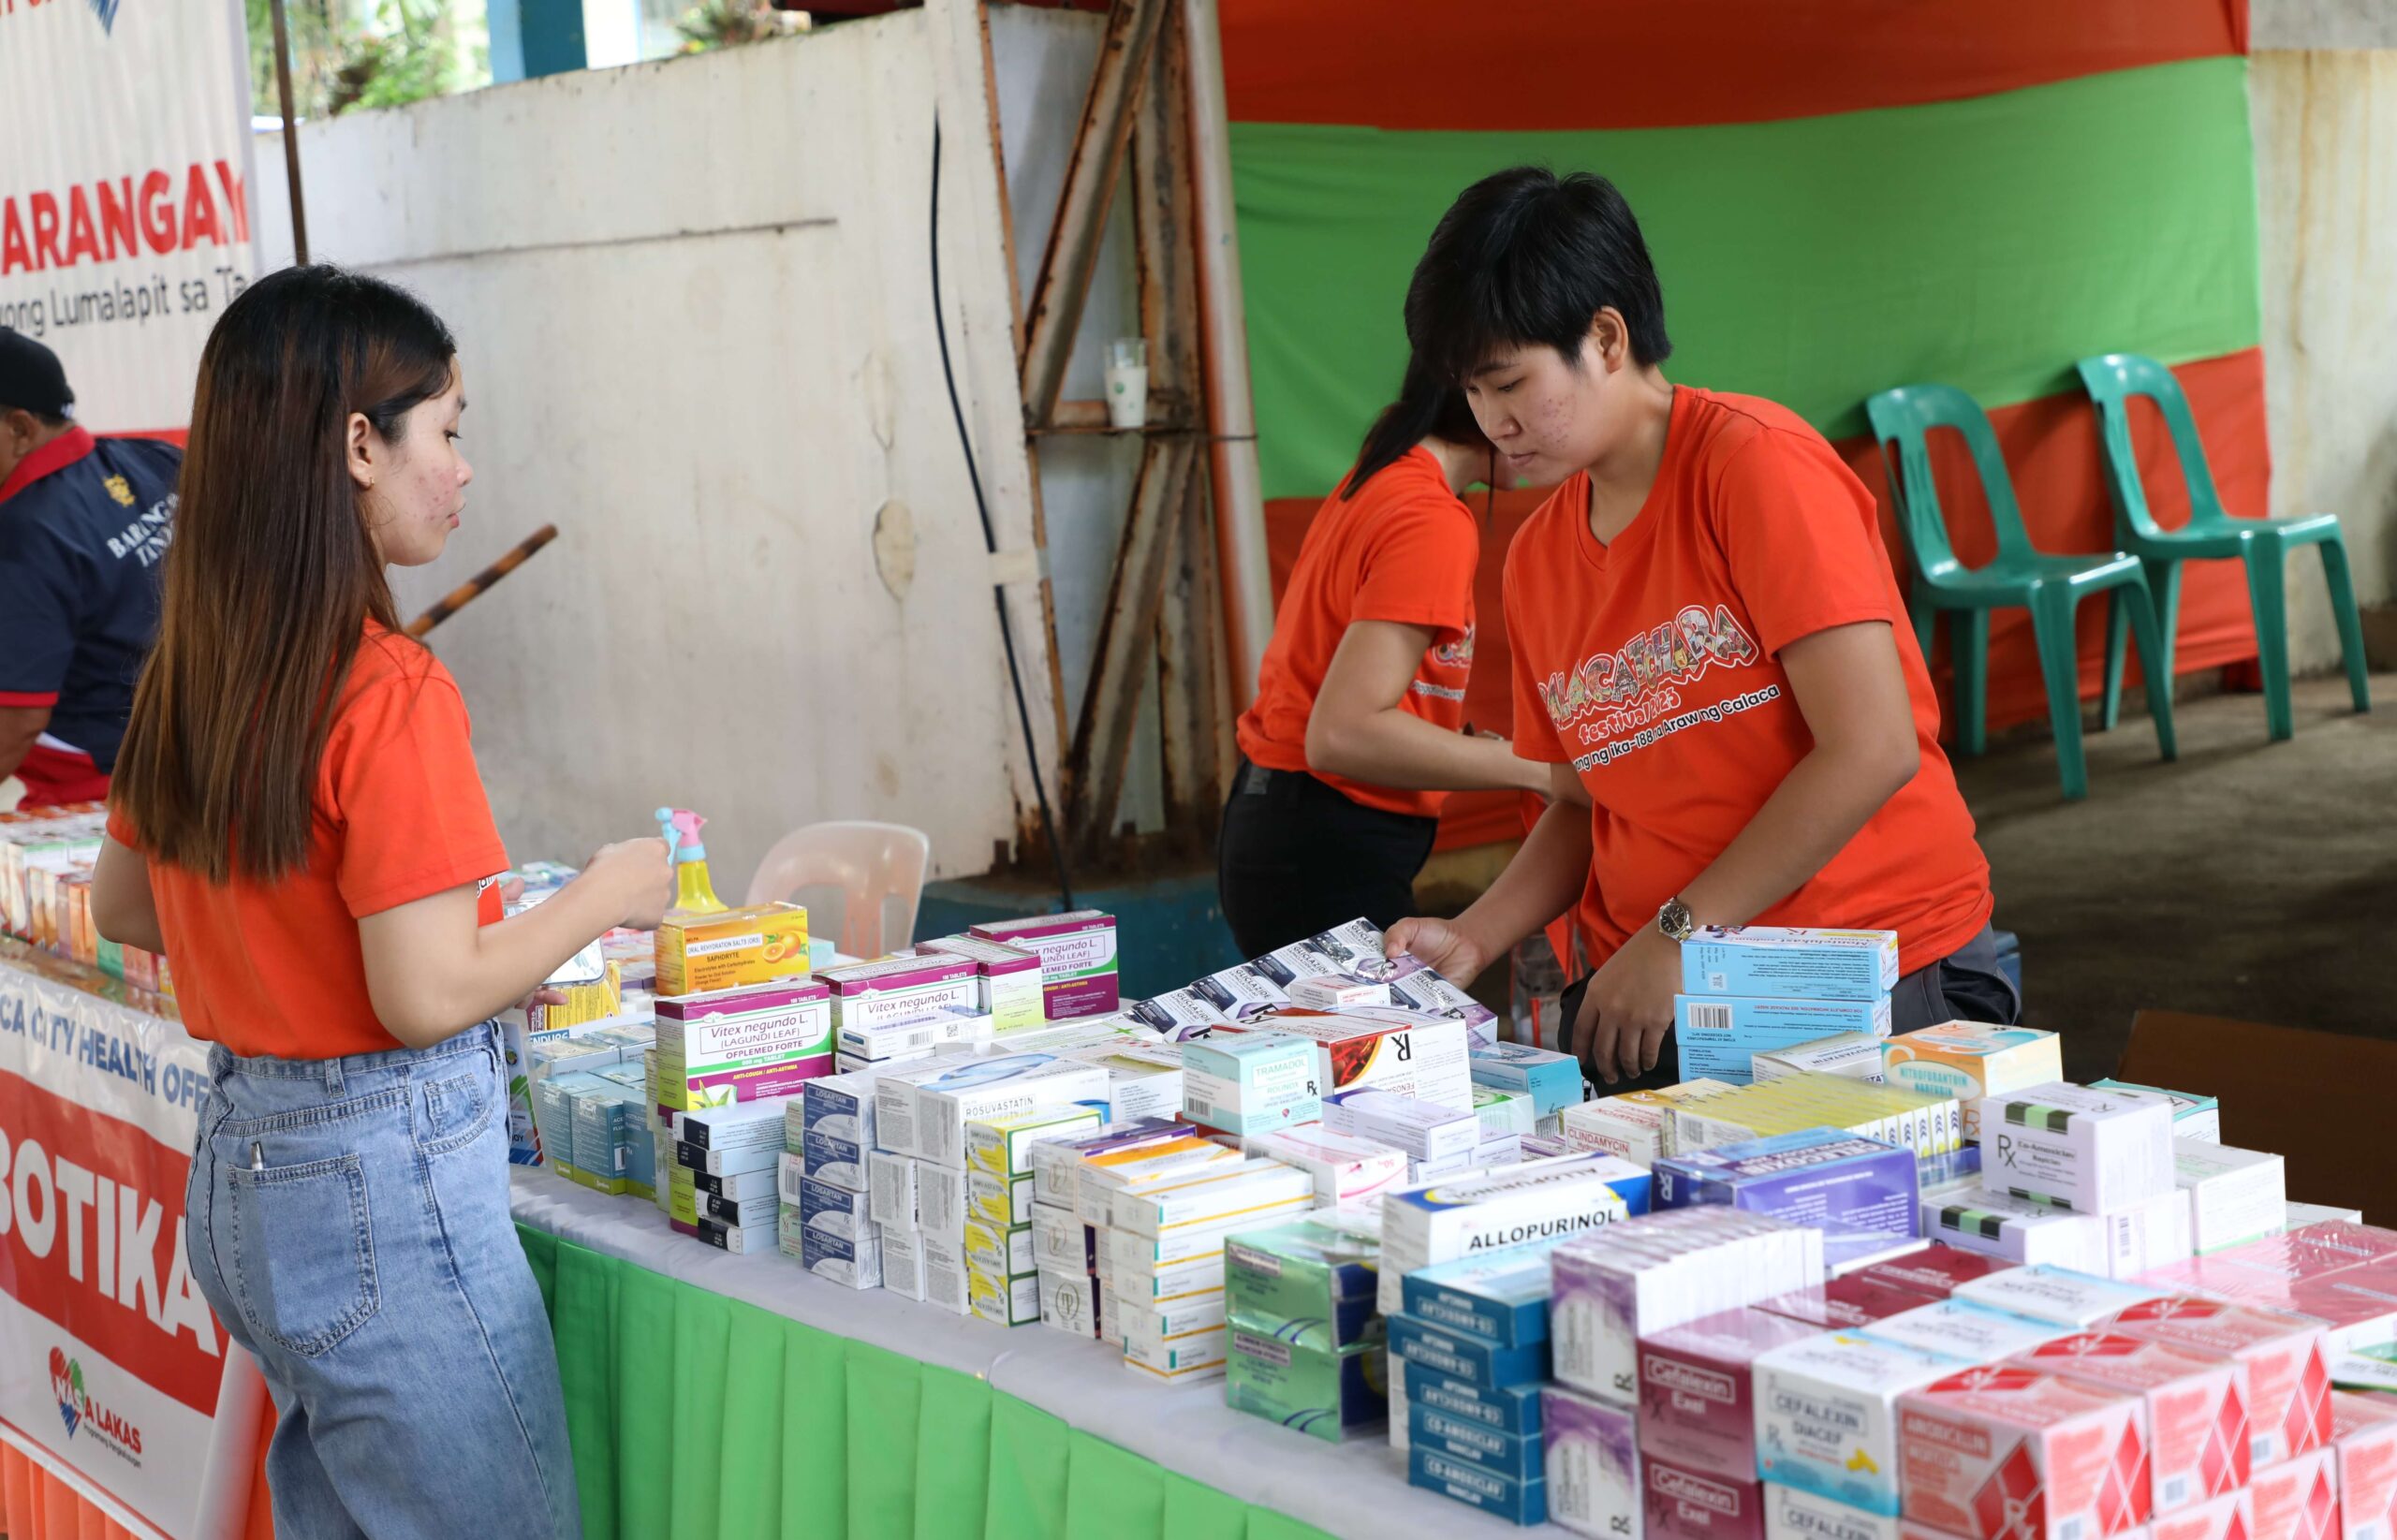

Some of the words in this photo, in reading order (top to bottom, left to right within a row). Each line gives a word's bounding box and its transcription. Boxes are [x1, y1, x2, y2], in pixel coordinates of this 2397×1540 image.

[51, 274, 171, 328] Lumalapit
[182, 279, 209, 313] sa
[1579, 703, 1651, 745] festival
[1650, 687, 1682, 720] 2023
[1591, 749, 1610, 765] ng
[1610, 732, 1654, 758] ika-188
[1663, 709, 1699, 735] Araw
[1700, 705, 1721, 723] ng
[1720, 684, 1781, 714] Calaca
[1042, 941, 1087, 955] negundo
[1350, 923, 1385, 954] GLICLAZID
[1041, 964, 1067, 975] LEMED
[1068, 961, 1093, 970] FORTE
[1292, 945, 1330, 975] GLICLAZIDE
[949, 971, 967, 979] TABLETS
[1235, 968, 1272, 999] GLICLAZIDE
[798, 994, 816, 1003] TABLETS
[867, 1002, 897, 1015] Vitex
[900, 992, 949, 1009] negundo
[950, 990, 960, 1000] L.
[1176, 991, 1212, 1023] GLICLAZIDE
[711, 1025, 741, 1039] Vitex
[744, 1017, 797, 1034] negundo
[799, 1014, 809, 1024] L.
[720, 1032, 772, 1049] (LAGUNDI
[772, 1027, 801, 1039] LEAF)
[31, 1006, 77, 1057] CITY
[79, 1028, 157, 1096] HEALTH
[726, 1046, 773, 1060] OFPLEMED
[775, 1039, 803, 1052] FORTE
[763, 1053, 786, 1063] TABLET
[732, 1070, 763, 1080] ANTI-COUGH
[766, 1063, 799, 1075] ANTI-ASTHMA
[1255, 1058, 1306, 1077] TRAMADOL
[815, 1088, 847, 1105] LOSARTAN
[964, 1097, 1035, 1117] ROSUVASTATIN
[1567, 1127, 1629, 1153] CLINDAMYCIN
[810, 1183, 843, 1201] LOSARTAN
[812, 1231, 844, 1250] LOSARTAN
[1468, 1208, 1619, 1251] ALLOPURINOL
[1775, 1393, 1861, 1430] CEFALEXIN
[96, 1401, 142, 1455] LAKAS
